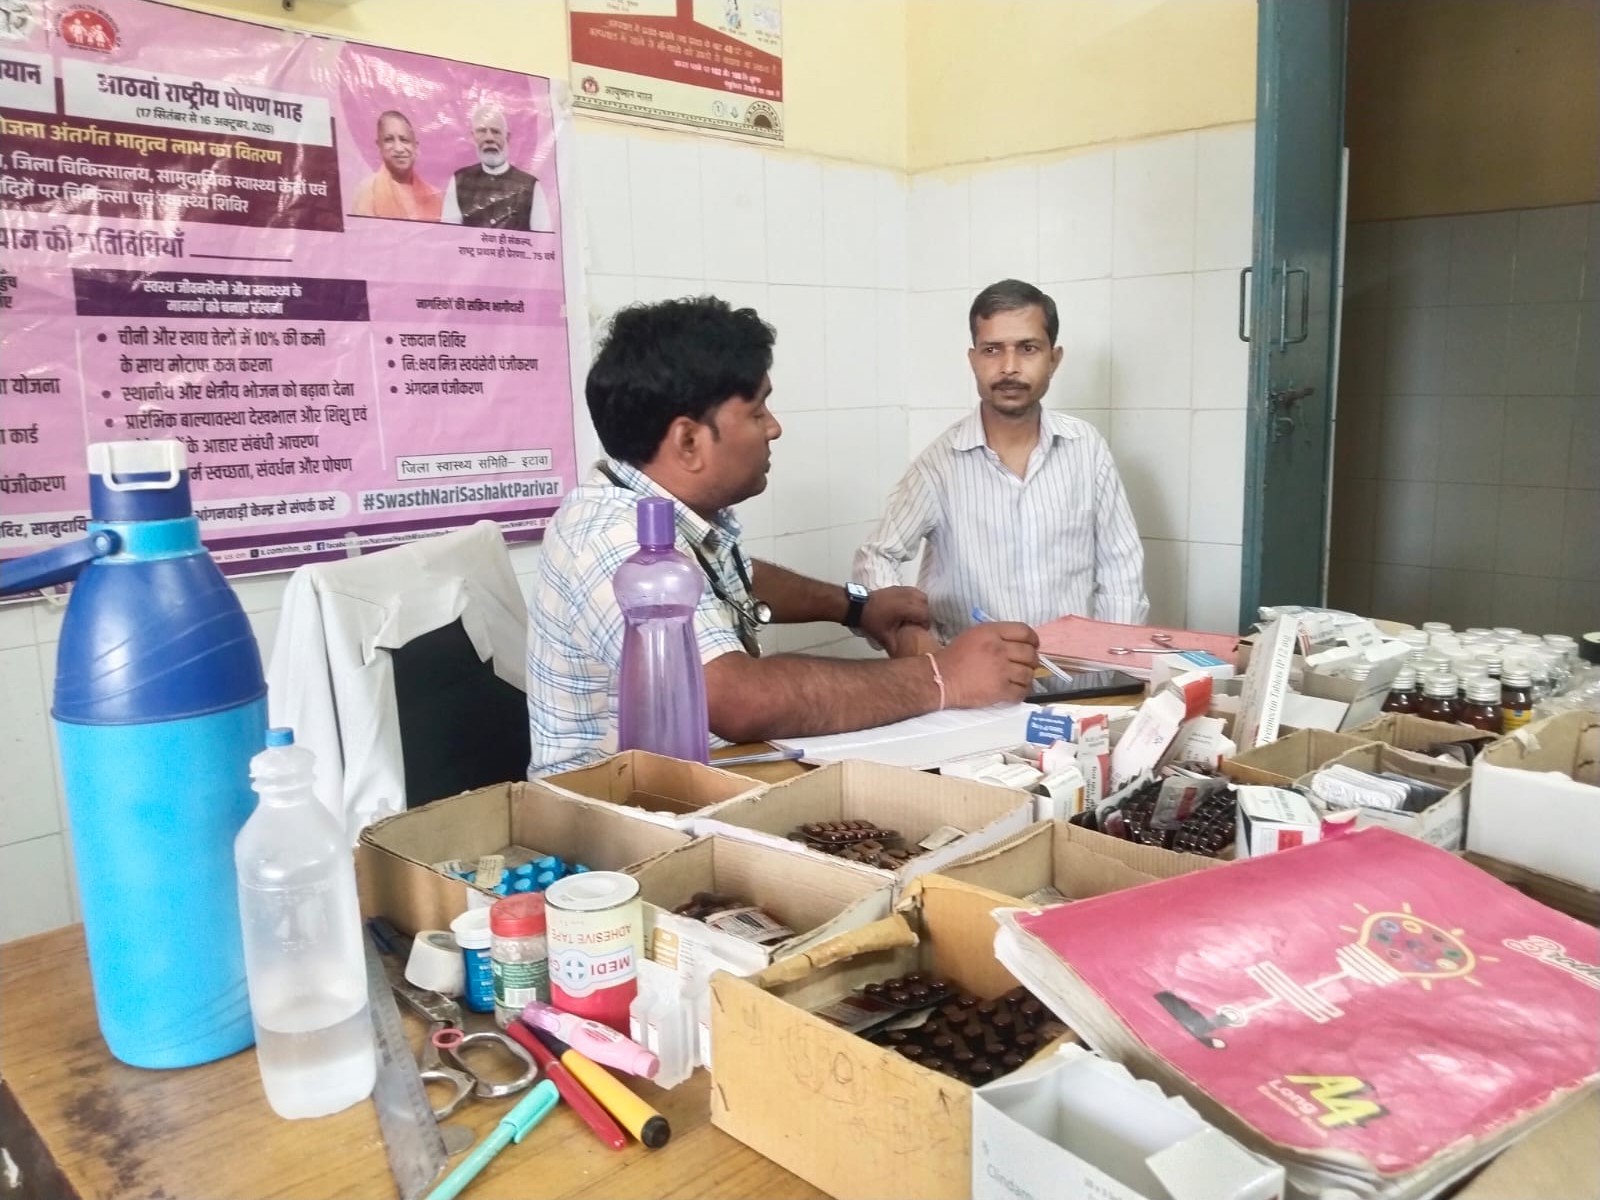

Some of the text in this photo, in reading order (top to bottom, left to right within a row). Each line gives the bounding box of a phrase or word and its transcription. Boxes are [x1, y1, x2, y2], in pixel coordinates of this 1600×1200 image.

[0, 59, 42, 84] यान
[164, 81, 220, 110] राष्ट्रीय
[224, 87, 271, 116] पोषण
[273, 100, 303, 122] माह
[136, 107, 151, 118] (17
[189, 111, 199, 123] से
[200, 115, 211, 125] 16
[252, 121, 275, 134] 2025)
[0, 117, 283, 165] ोजना अंतर्गत मातृत्व लाभ का वितरण
[12, 150, 55, 173] जिला
[57, 155, 154, 184] चिकित्सालय,
[155, 169, 233, 191] सामुदायिक
[234, 176, 276, 193] स्वास्थ्य
[309, 181, 329, 198] एवं
[38, 183, 61, 200] पर
[62, 182, 129, 204] चिकित्सा
[131, 188, 154, 206] एवं
[212, 193, 249, 213] शिविर
[43, 224, 72, 253] की
[533, 252, 543, 261] 75
[231, 281, 250, 296] और
[291, 282, 303, 297] के
[454, 297, 466, 311] की
[117, 325, 326, 347] चीनी और खाद्य तेलों में 10% की कमी
[399, 330, 467, 348] रक्तदान शिविर
[120, 354, 273, 373] के साथ मोटापा कम करना
[438, 354, 457, 371] मित्र
[459, 354, 497, 371] स्वयंसेवी
[498, 354, 539, 371] पंजीकरण
[10, 373, 61, 395] योजना
[121, 379, 355, 401] स्थानीय और क्षेत्रीय भोजन को बढ़ावा देना
[404, 377, 484, 395] अंगदान पंजीकरण
[124, 404, 369, 431] प्रारंभिक बाल्यावस्था देखभाल और शिशु एवं
[8, 422, 40, 444] कार्ड
[185, 436, 200, 454] के
[202, 438, 239, 454] आहार
[241, 432, 275, 452] संबंधी
[277, 433, 319, 450] आचरण
[205, 463, 254, 482] स्वच्छता,
[255, 457, 296, 478] संवर्धन
[298, 456, 321, 474] और
[322, 455, 353, 472] पोषण
[401, 461, 431, 476] जिला
[436, 459, 474, 474] स्वास्थ्य
[521, 455, 549, 468] इटावा
[0, 472, 66, 494] पंजीकरण
[362, 480, 560, 511] #SwasthNariSashaktParivar
[29, 515, 93, 538] सामुदायि
[250, 502, 274, 518] केन्द्र
[276, 500, 288, 516] से
[289, 497, 316, 514] संपर्क
[317, 496, 336, 512] करें
[1281, 634, 1292, 647] mg
[1275, 659, 1286, 670] IP
[1270, 671, 1284, 698] Tablets
[1261, 700, 1279, 743] Ivermectin
[550, 924, 632, 944] ADHESIVE TAPE
[590, 955, 630, 976] MEDI
[1268, 1079, 1319, 1115] Long
